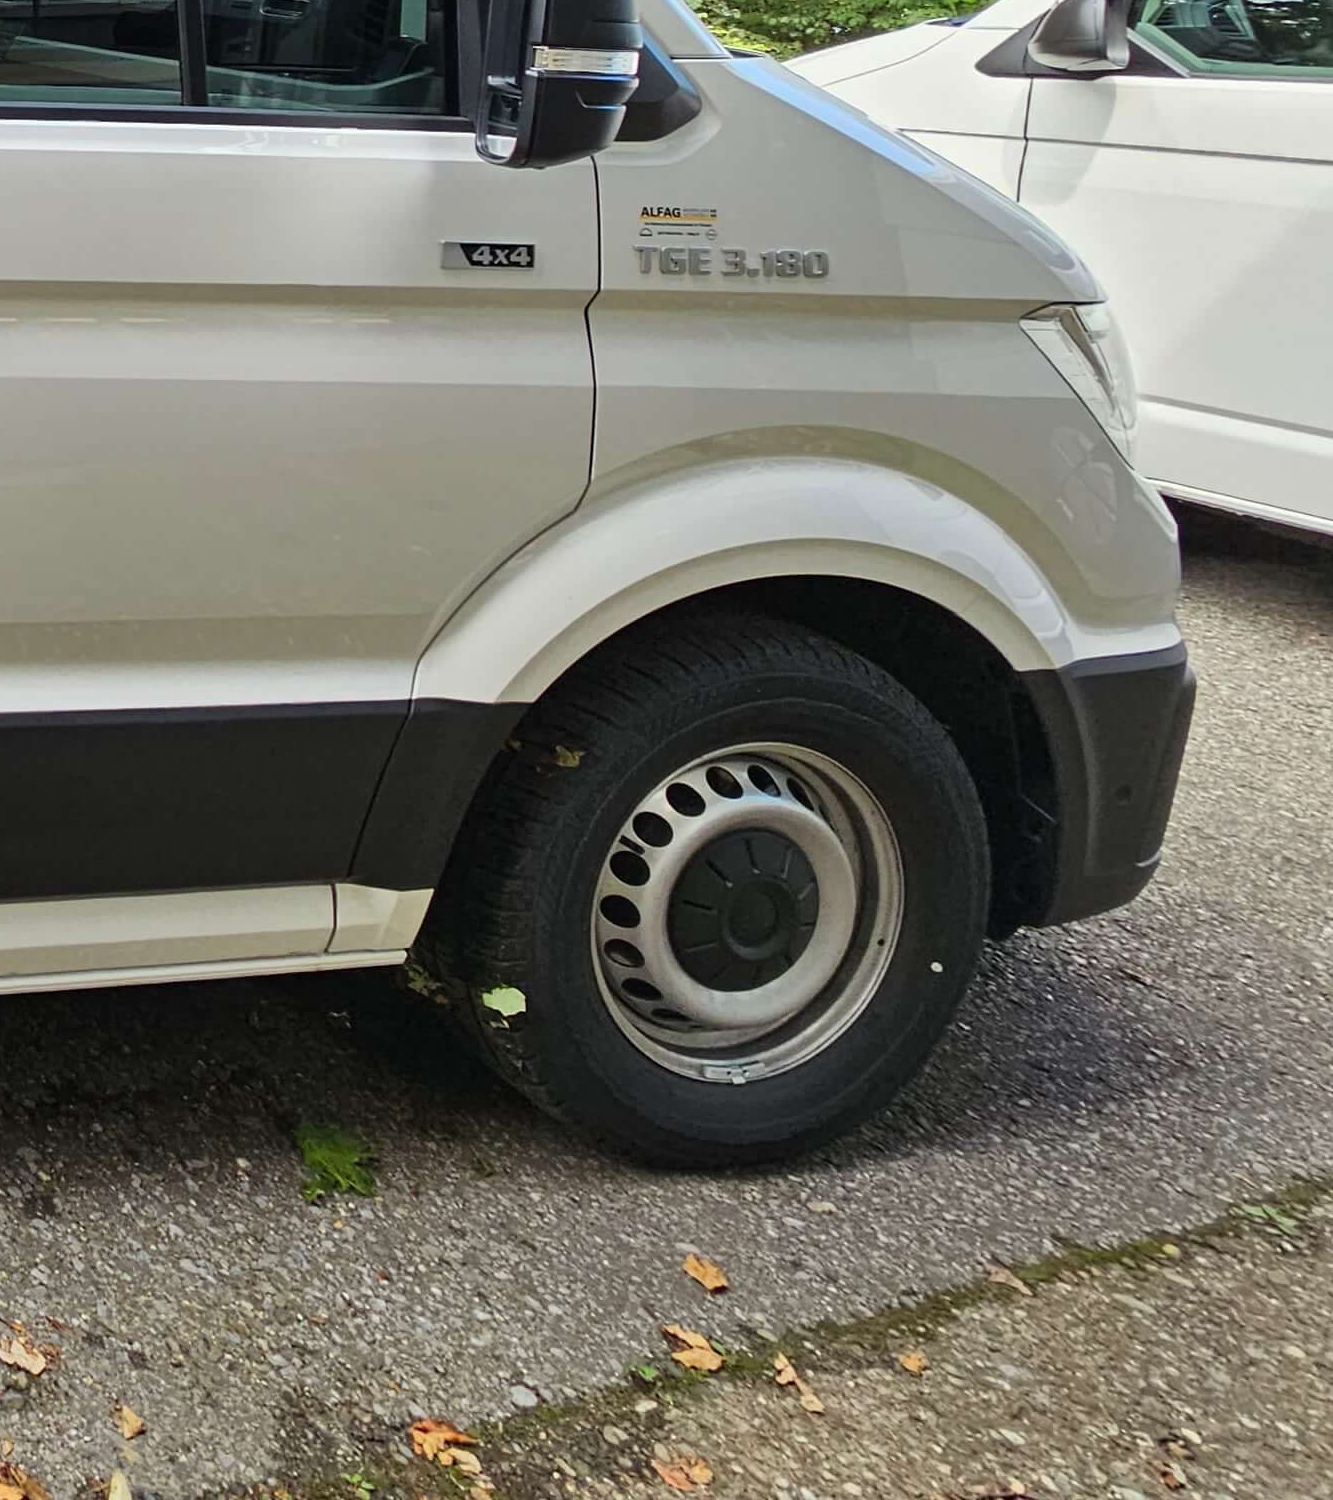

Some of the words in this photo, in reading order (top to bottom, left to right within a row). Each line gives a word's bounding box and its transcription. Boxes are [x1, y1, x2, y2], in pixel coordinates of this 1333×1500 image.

[641, 206, 681, 218] ALFAG
[472, 245, 531, 266] 4x4
[633, 245, 712, 276] TGE
[721, 247, 830, 278] 3.180
